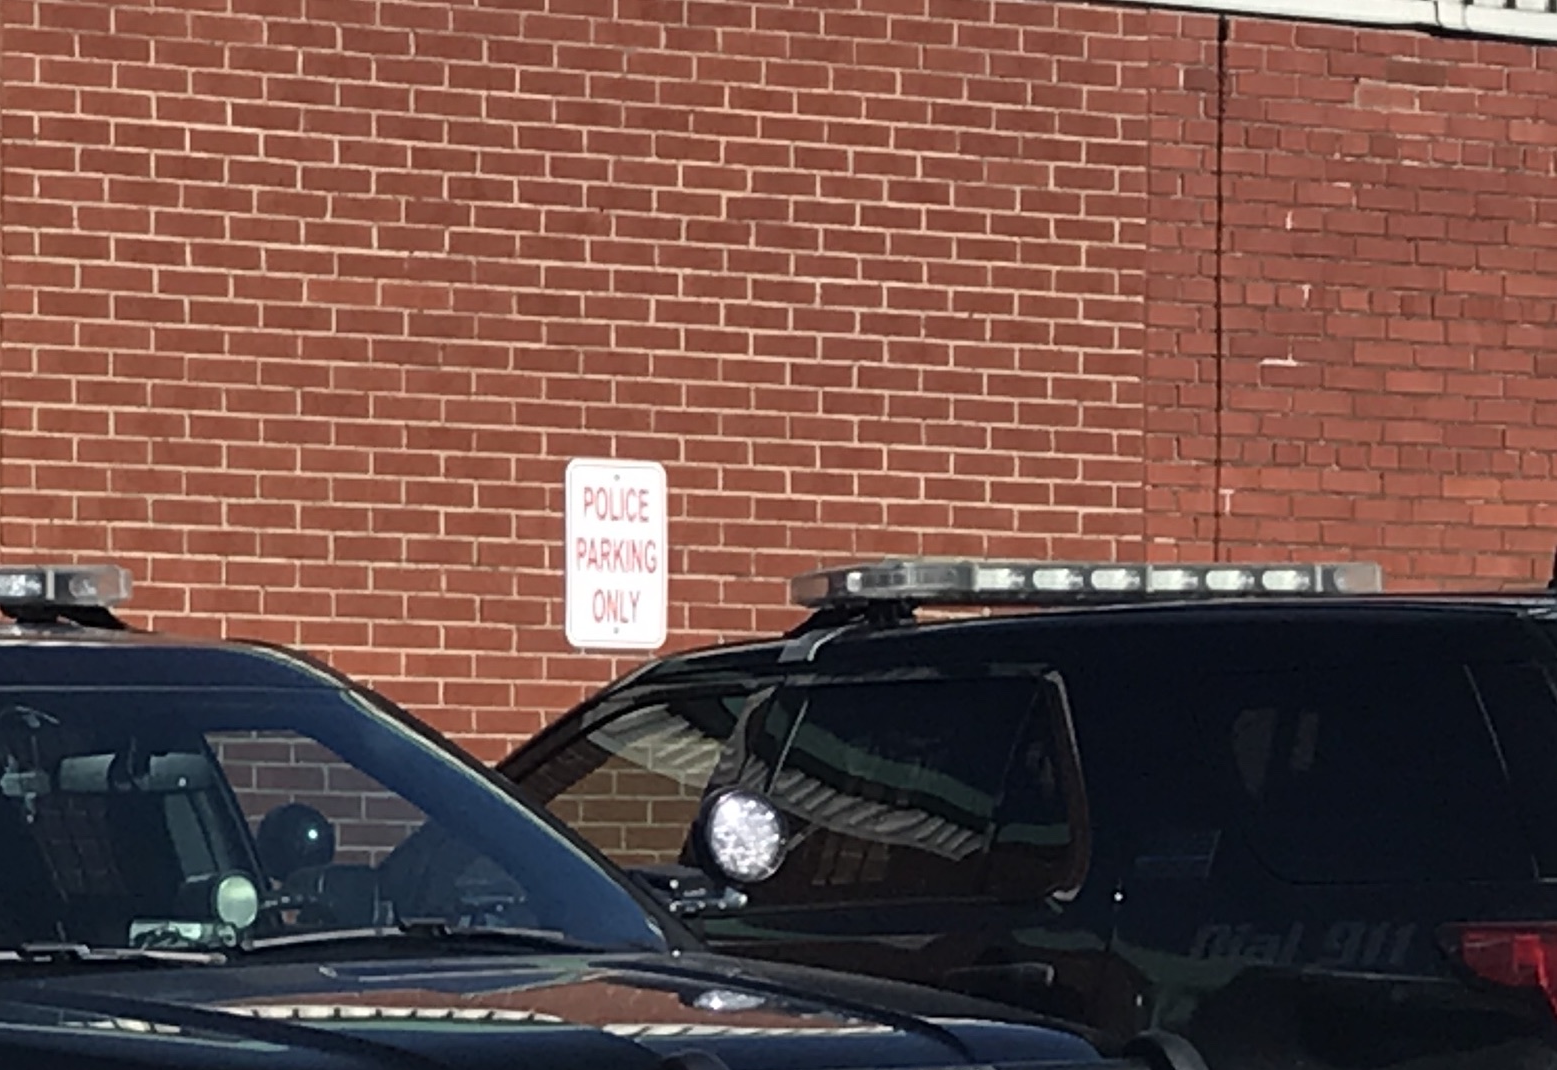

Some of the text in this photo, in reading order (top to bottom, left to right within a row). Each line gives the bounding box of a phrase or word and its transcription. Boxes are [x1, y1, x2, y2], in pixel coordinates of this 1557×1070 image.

[583, 486, 650, 523] POLICE
[576, 537, 658, 574] PARKING
[592, 588, 641, 624] ONLY
[1190, 920, 1417, 967] Dial 911
